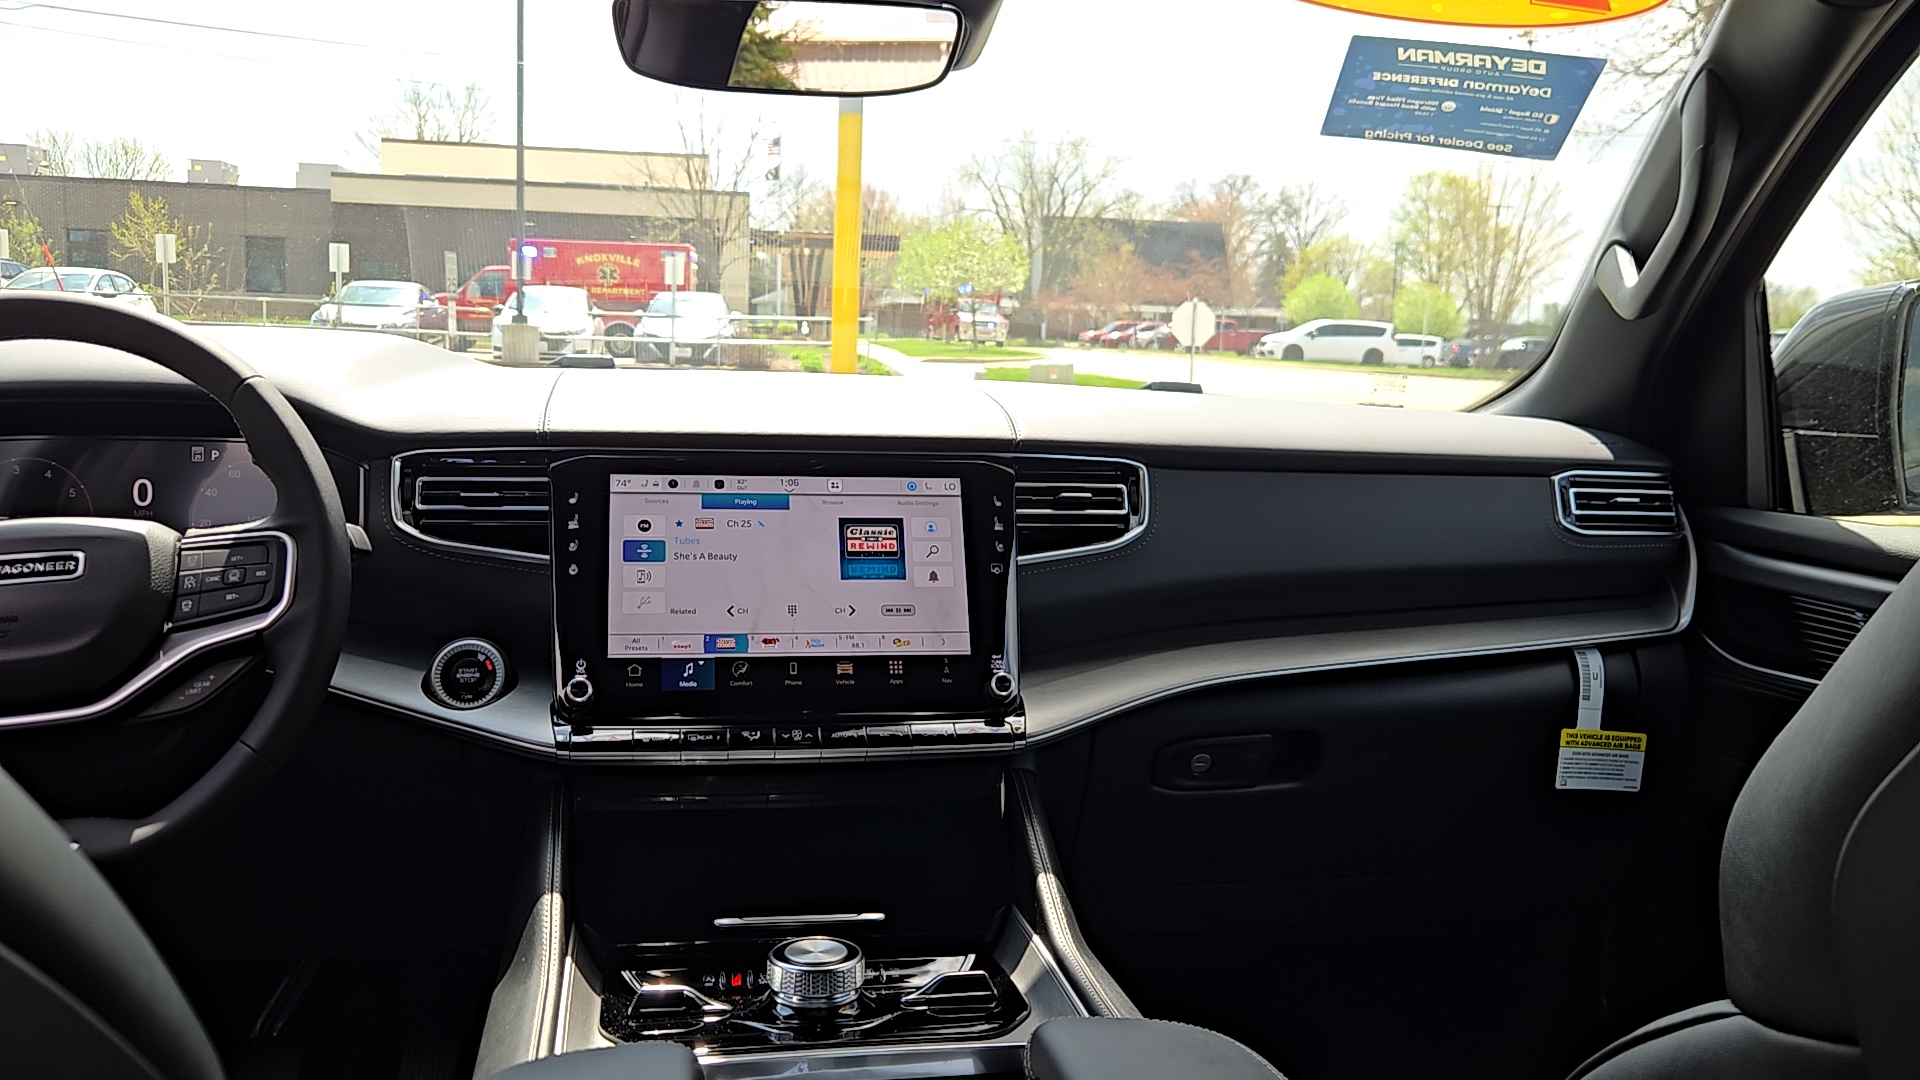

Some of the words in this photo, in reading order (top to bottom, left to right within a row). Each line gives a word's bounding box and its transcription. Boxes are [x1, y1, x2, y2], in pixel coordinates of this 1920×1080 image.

[576, 253, 641, 268] KNOXVILLE
[591, 286, 646, 296] DEPARTMENT
[211, 449, 220, 461] P
[12, 465, 20, 475] 3
[44, 469, 52, 479] 4
[228, 469, 241, 479] 60
[780, 478, 800, 487] 1:06
[943, 482, 957, 491] LO
[69, 487, 76, 498] 5
[132, 478, 153, 507] 0
[205, 488, 218, 497] 40
[734, 498, 757, 506] Playing
[897, 499, 914, 507] Audio
[915, 500, 939, 508] Settings
[726, 519, 739, 528] Ch
[740, 519, 752, 528] 25
[849, 528, 895, 536] Classic
[674, 537, 701, 545] Tubes
[850, 542, 896, 550] REWIND
[673, 551, 698, 561] She's
[699, 552, 706, 560] A
[707, 552, 738, 562] Beauty
[0, 560, 77, 575] AGONEER
[670, 607, 697, 615] Related
[737, 607, 749, 615] CH
[834, 607, 846, 615] CH
[624, 644, 648, 652] Presets
[193, 680, 211, 688] GEAR
[679, 680, 698, 688] Media
[1565, 732, 1579, 740] THIS
[1580, 733, 1604, 741] VEHICLE
[1612, 735, 1642, 743] EQUIPPED
[1581, 740, 1612, 748] ADVANCED
